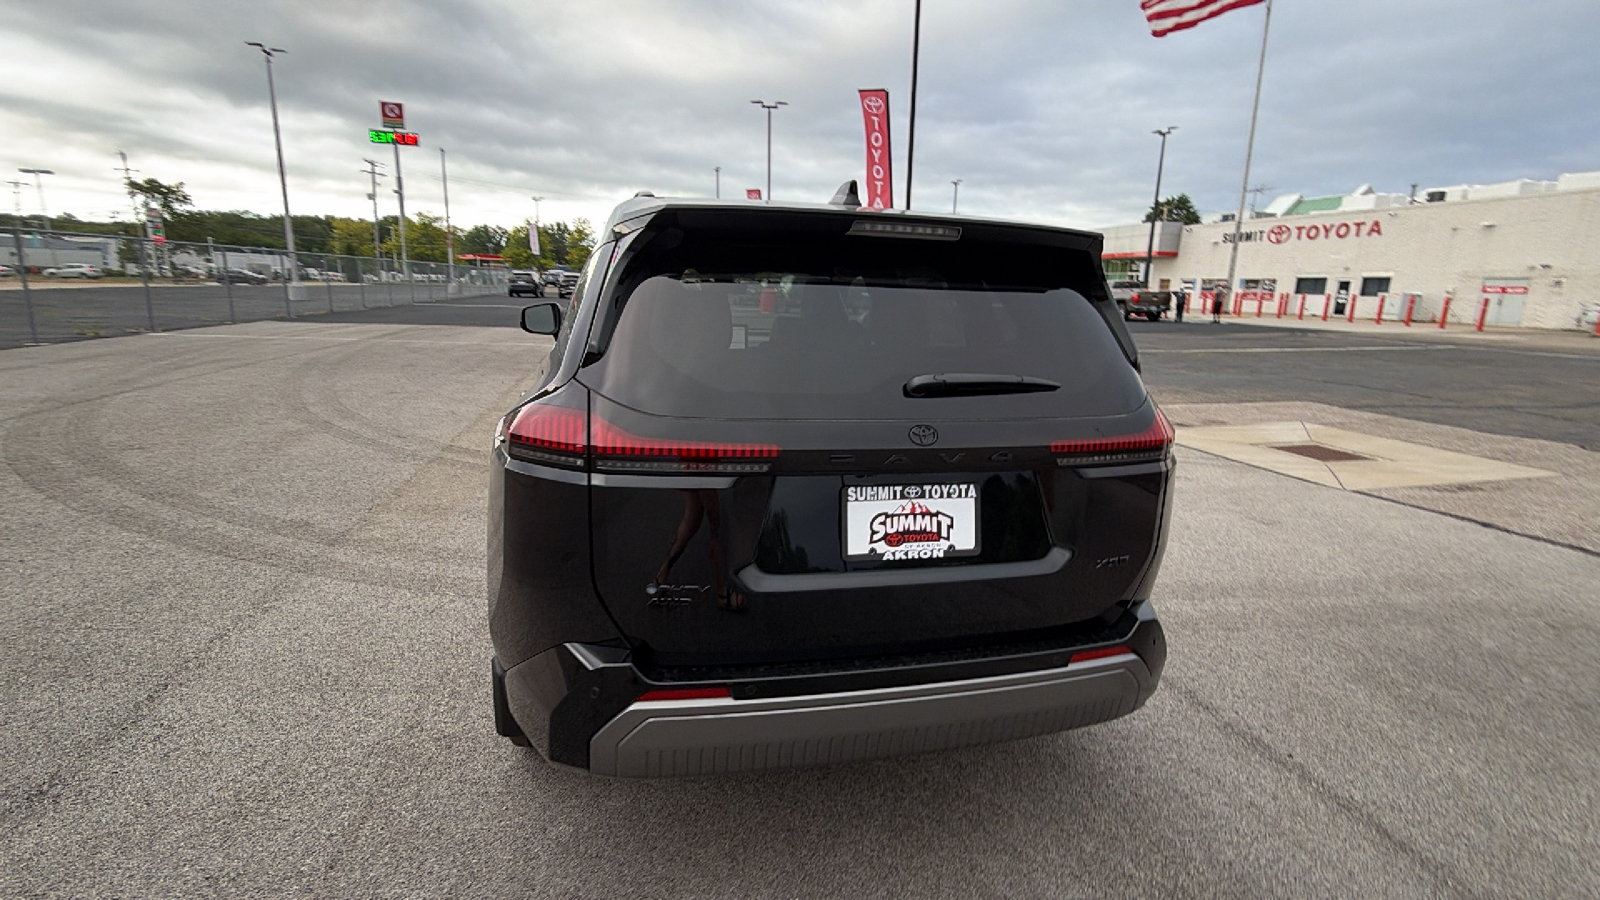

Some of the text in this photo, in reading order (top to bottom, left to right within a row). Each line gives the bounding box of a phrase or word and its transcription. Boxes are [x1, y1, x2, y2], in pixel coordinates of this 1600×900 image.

[870, 116, 884, 208] TOYOTA
[1295, 220, 1383, 241] TOYOTA
[847, 484, 977, 501] SUMMIT TOYOTA
[870, 511, 953, 543] SUMMIT
[904, 533, 939, 542] TOYOTA
[882, 548, 945, 560] AKRON
